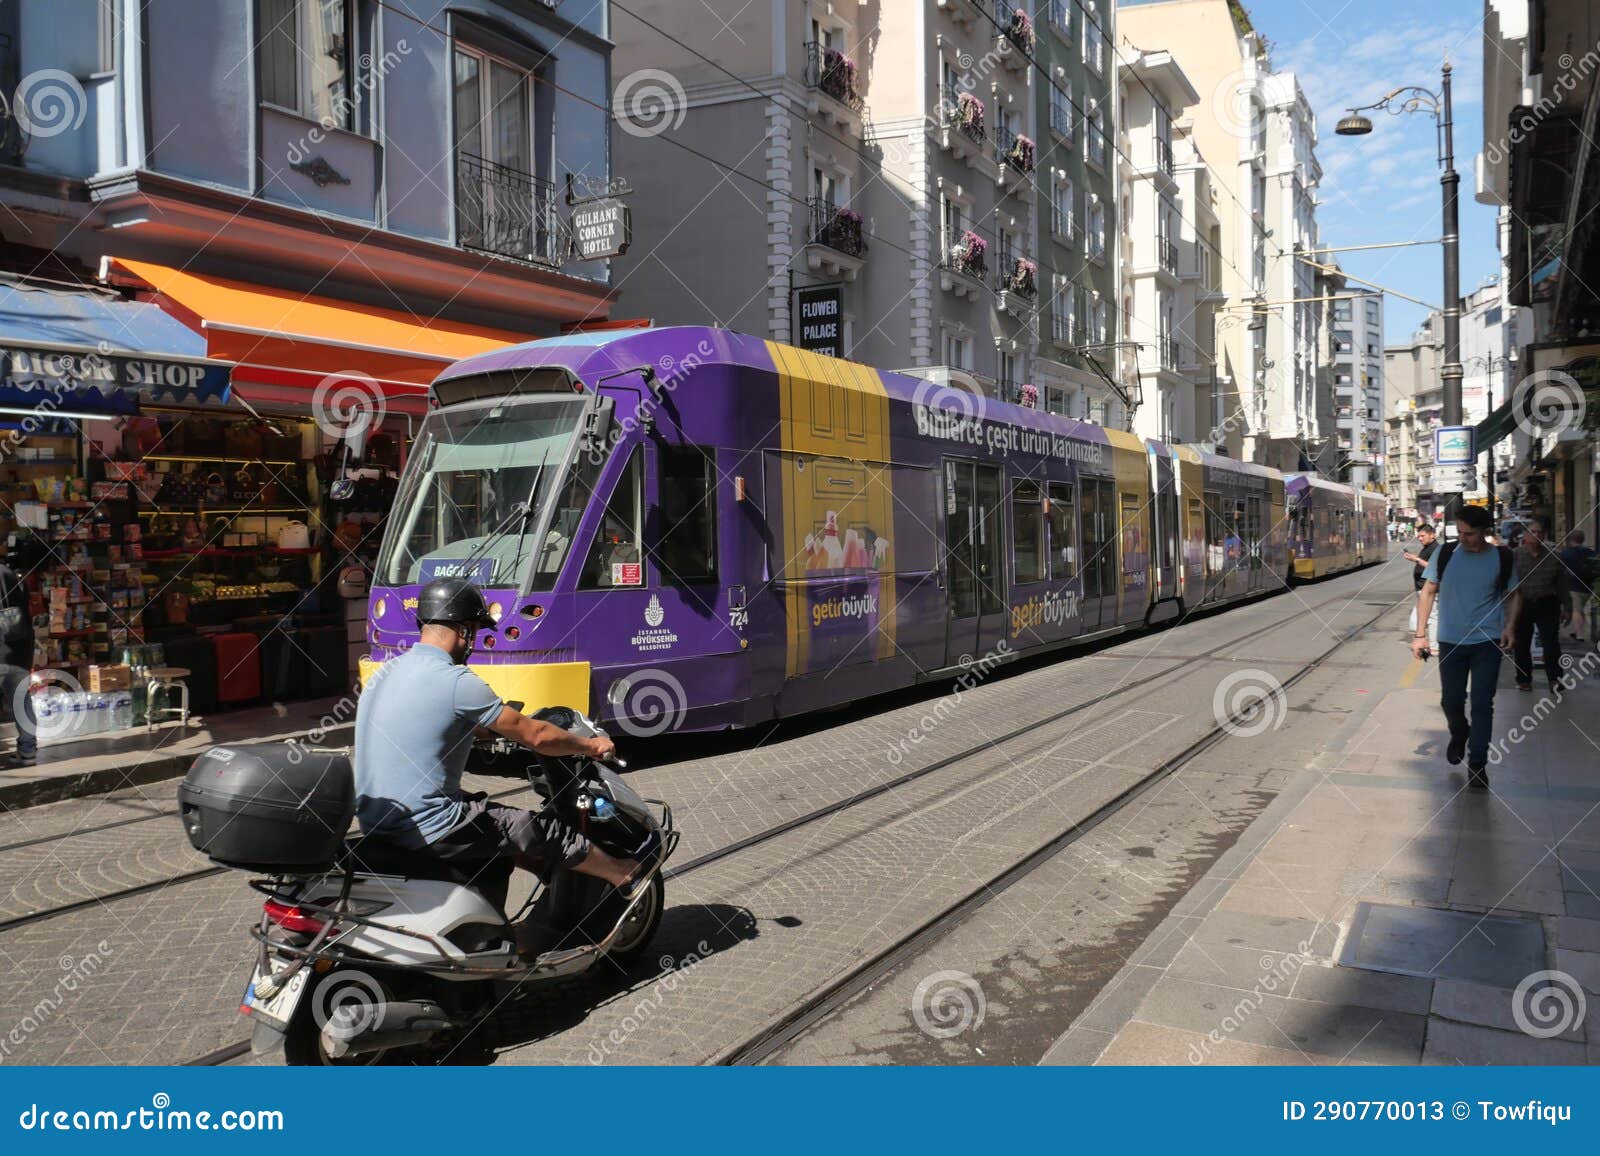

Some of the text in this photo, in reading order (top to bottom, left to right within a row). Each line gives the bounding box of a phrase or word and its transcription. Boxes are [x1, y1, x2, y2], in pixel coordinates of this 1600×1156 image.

[575, 207, 618, 228] GÜLHANE
[579, 222, 615, 241] CORNER
[583, 237, 611, 255] HOTEL
[802, 299, 838, 318] FLOWER
[804, 323, 837, 340] PALACE
[126, 360, 206, 388] SHOP
[916, 404, 983, 446] Binlerce
[986, 422, 1019, 457] çeşit
[1021, 425, 1049, 455] ürün
[729, 610, 749, 627] 724
[812, 594, 877, 626] getirbüyük
[1011, 590, 1079, 638] getirbüyük
